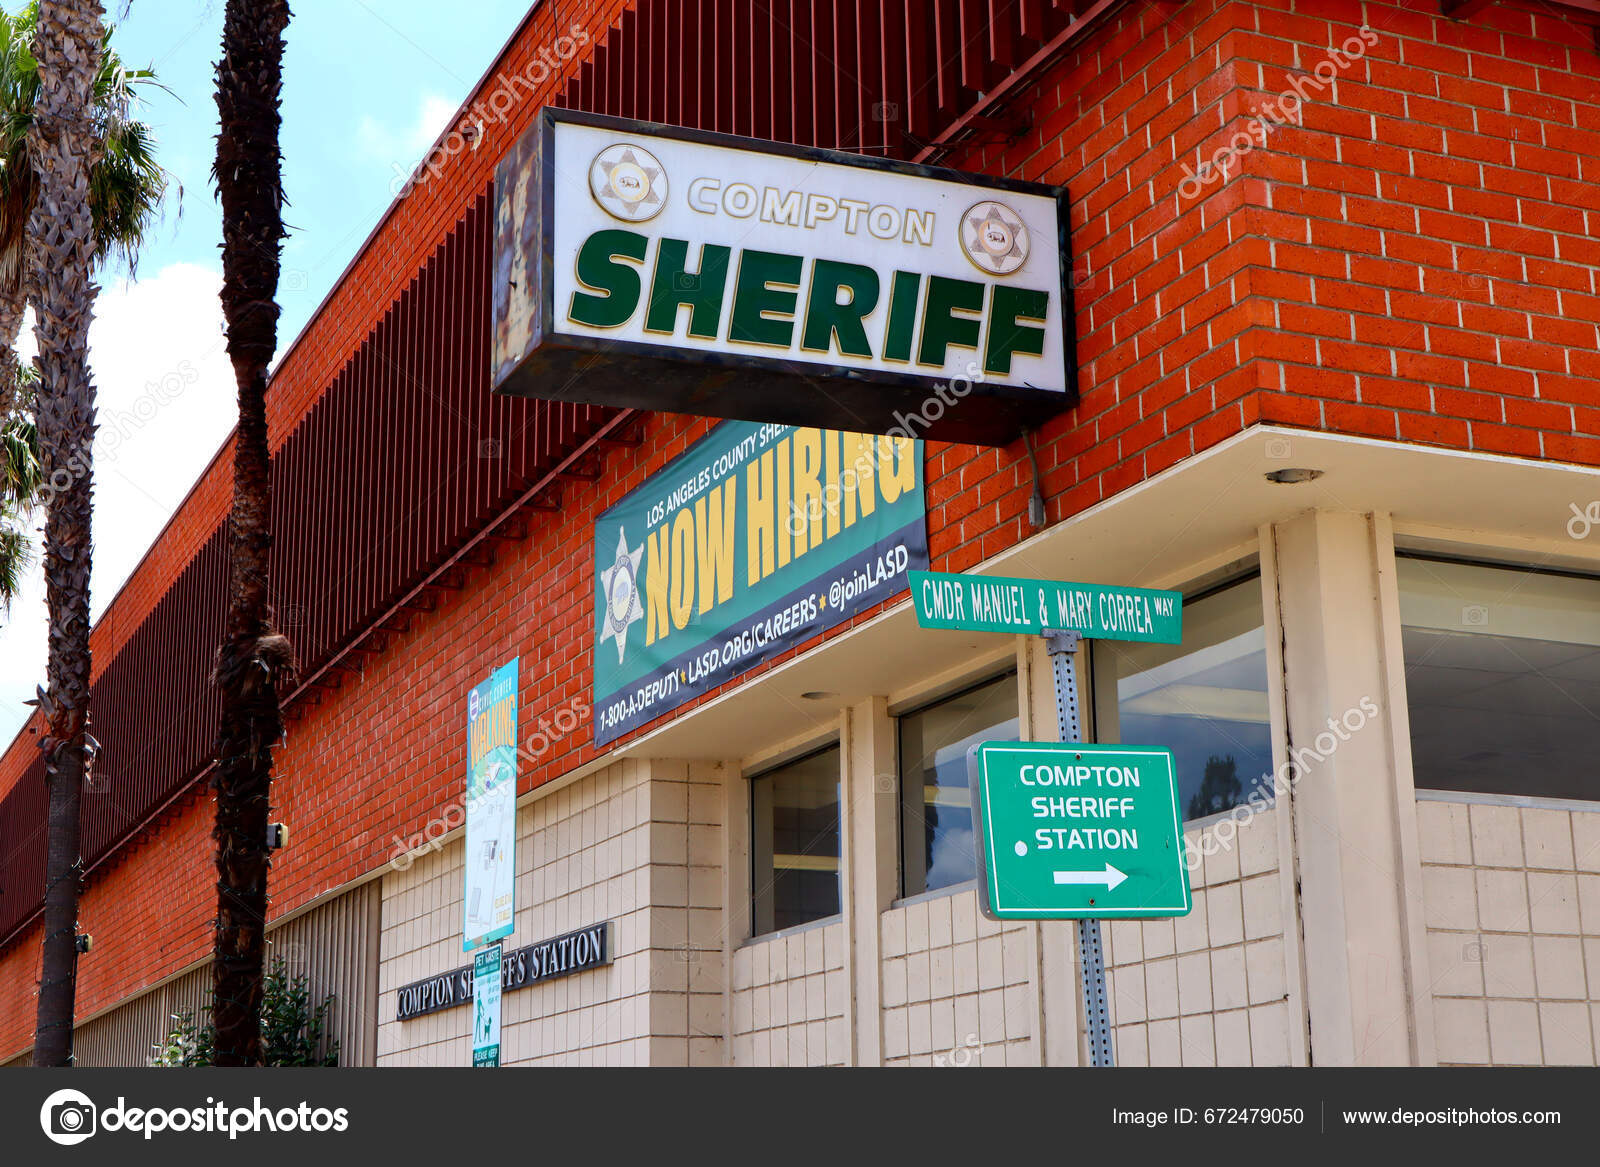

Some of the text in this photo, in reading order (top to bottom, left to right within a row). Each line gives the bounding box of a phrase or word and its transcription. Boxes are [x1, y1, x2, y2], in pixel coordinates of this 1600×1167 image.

[687, 176, 937, 246] COMPTON
[567, 229, 1050, 376] SHERIFF
[647, 423, 791, 529] LOS ANGELES COUNTY SHE
[645, 474, 736, 647] NOW
[747, 426, 916, 587] HIRING
[600, 668, 680, 731] 1-800-A-DEPUTY
[688, 593, 817, 684] LASD.ORG/CAREERS
[829, 544, 909, 612] @joinLASD
[922, 579, 1174, 634] CMDR MANUEL & MARY CORREA WAY
[470, 693, 516, 771] WALKING
[1019, 764, 1140, 787] COMPTON
[1031, 796, 1135, 818] SHERIFF
[1035, 828, 1138, 849] STATION
[397, 975, 455, 1017] COMPTON
[460, 951, 525, 999] SHFF'S
[532, 928, 602, 979] STATION
[475, 953, 485, 967] PET
